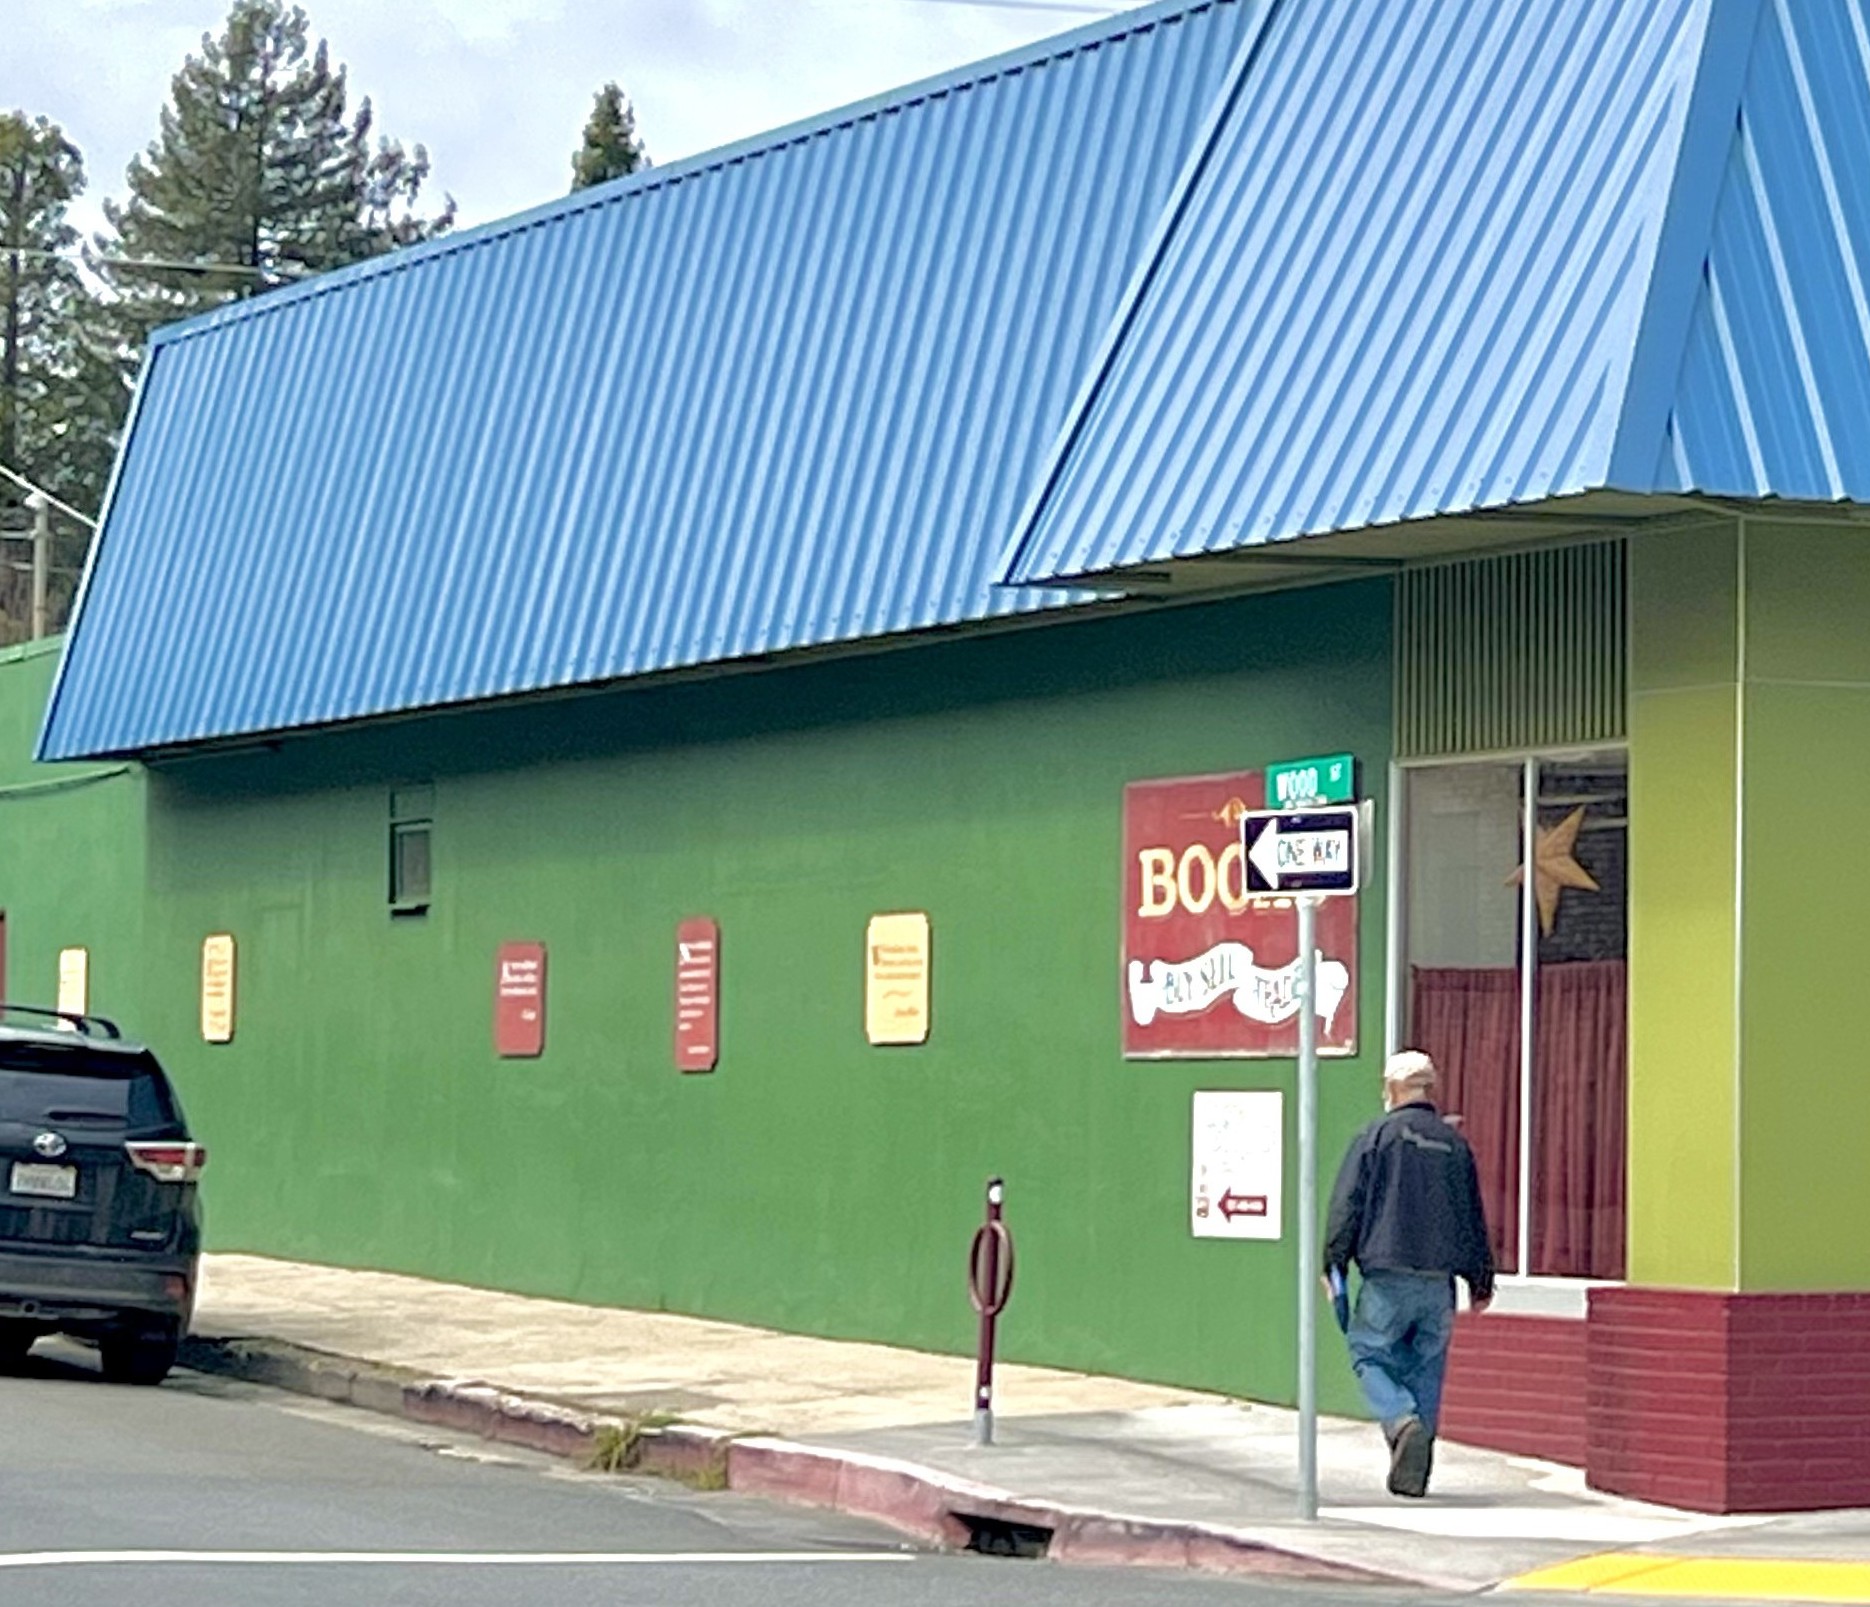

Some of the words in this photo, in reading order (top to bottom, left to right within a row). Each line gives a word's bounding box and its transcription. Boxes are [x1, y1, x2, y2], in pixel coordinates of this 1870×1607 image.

[1276, 767, 1318, 801] WOOD
[1277, 839, 1306, 868] ONE
[1312, 838, 1341, 865] WAY
[1138, 842, 1312, 917] BOO
